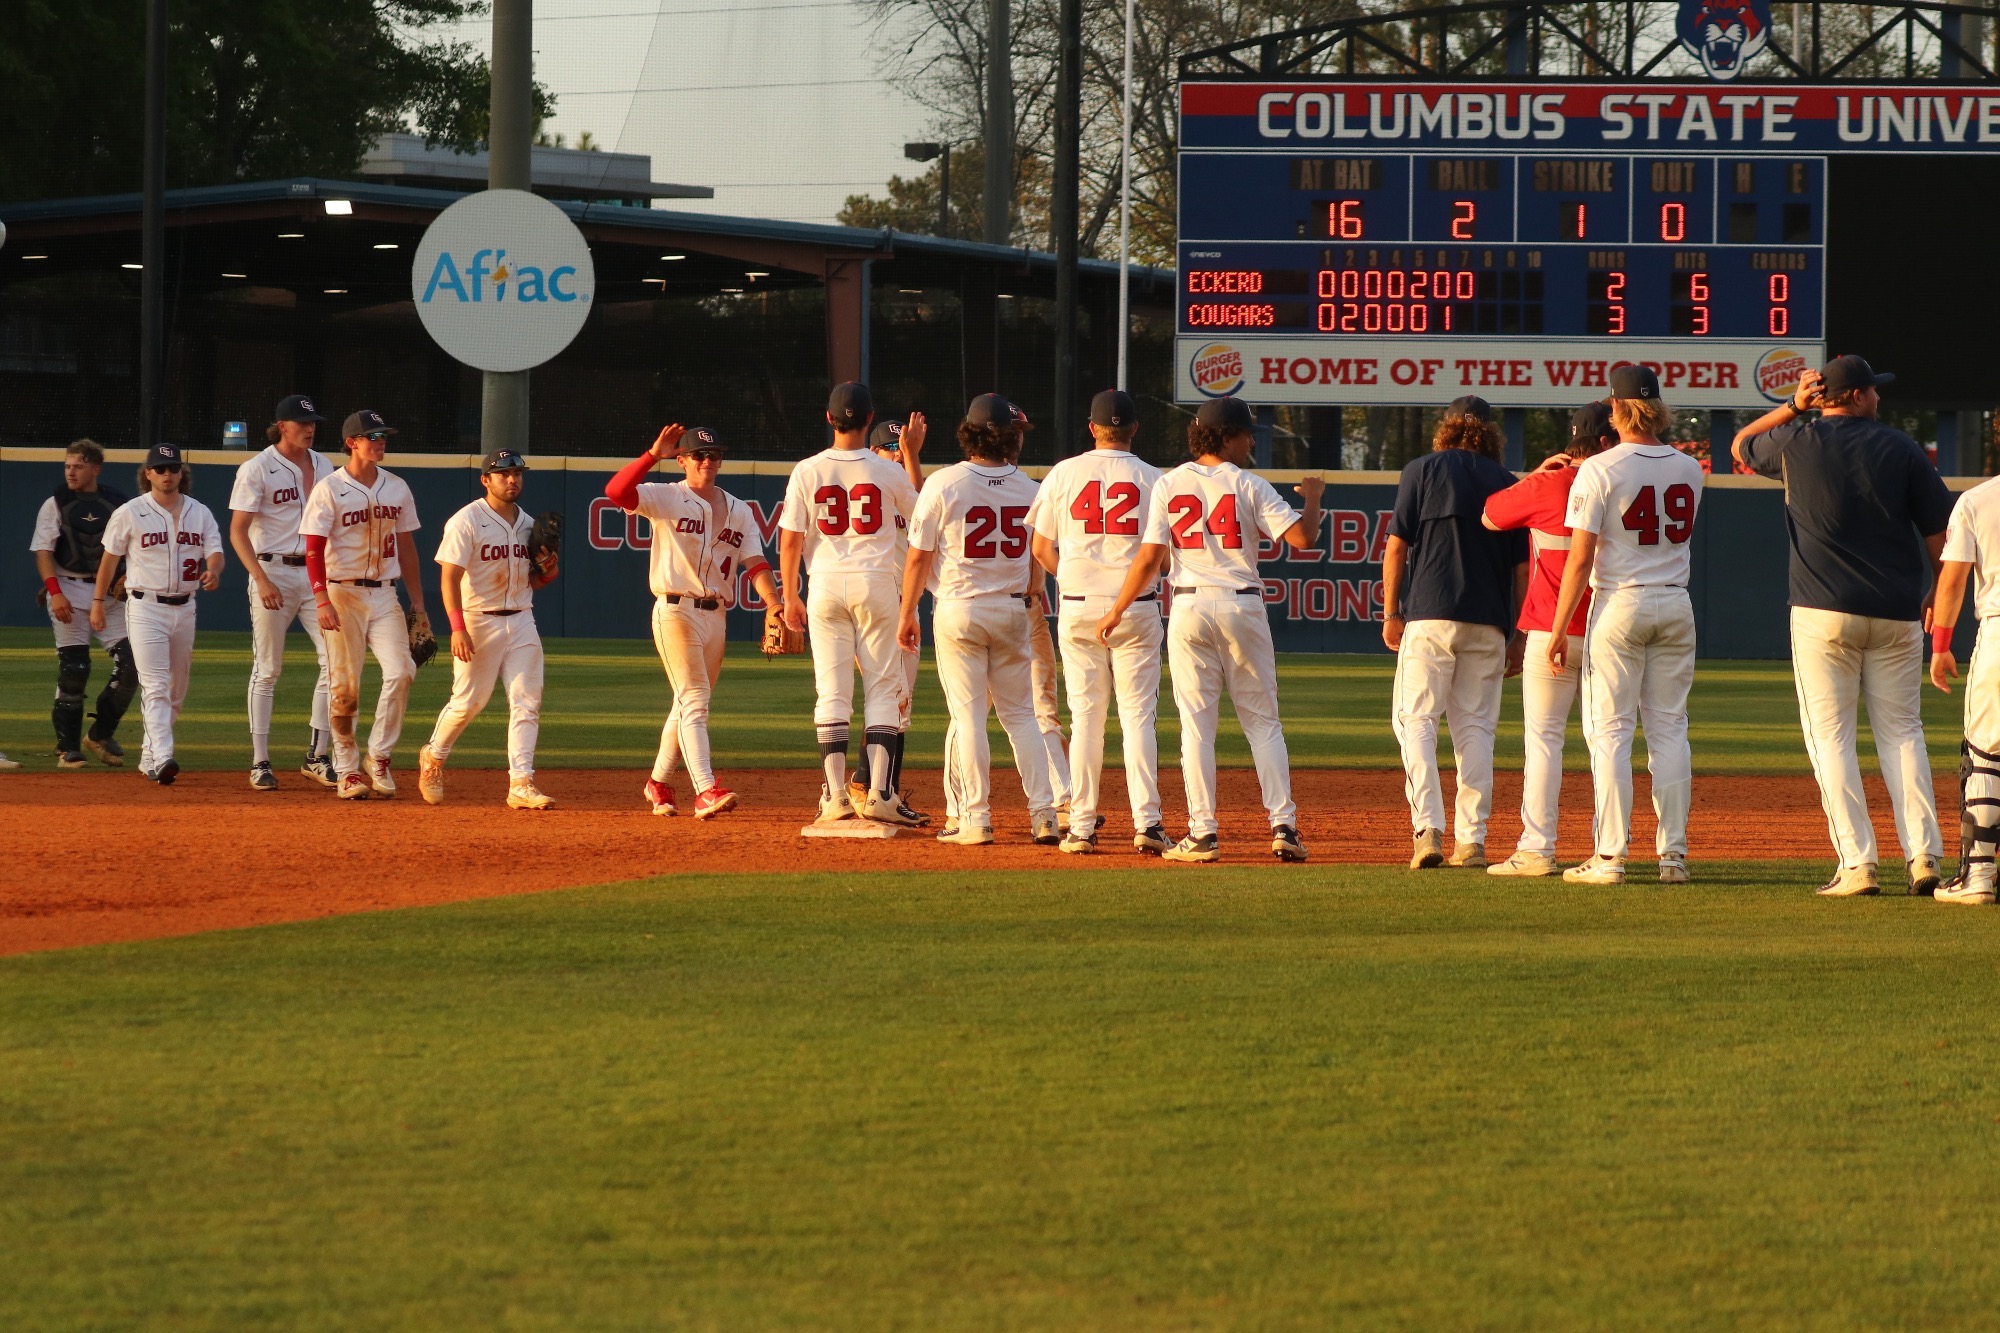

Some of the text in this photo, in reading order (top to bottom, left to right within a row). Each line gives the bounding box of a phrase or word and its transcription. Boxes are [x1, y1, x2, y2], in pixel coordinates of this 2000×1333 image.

[1257, 92, 1567, 140] COLUMBUS
[1599, 94, 1800, 141] STATE
[1300, 159, 1372, 190] AT BAT
[1438, 160, 1488, 191] BALL
[1534, 161, 1614, 192] STRIKE
[1652, 162, 1696, 193] OUT
[1328, 200, 1362, 238] 16
[1452, 201, 1475, 239] 2
[1578, 204, 1585, 238] 1
[1661, 203, 1685, 241] 0
[1415, 251, 1424, 267] 5
[421, 249, 578, 304] Aflac
[1187, 271, 1263, 293] ECKERD
[1606, 272, 1626, 300] 2
[1690, 273, 1709, 301] 6
[1769, 274, 1789, 302] 0
[1187, 304, 1275, 326] COUGARS
[1607, 305, 1625, 333] 3
[1692, 306, 1709, 334] 3
[1768, 307, 1788, 335] 0
[1195, 351, 1241, 373] BURGER
[1196, 361, 1243, 387] KING
[1259, 357, 1740, 389] HOME OF THE WHPER
[1759, 356, 1806, 378] BURGER
[813, 482, 883, 536] 33
[1069, 480, 1141, 536] 42
[1167, 493, 1243, 550] 24
[1620, 483, 1695, 546] 49
[963, 505, 1030, 559] 25
[480, 543, 531, 562] COUGA
